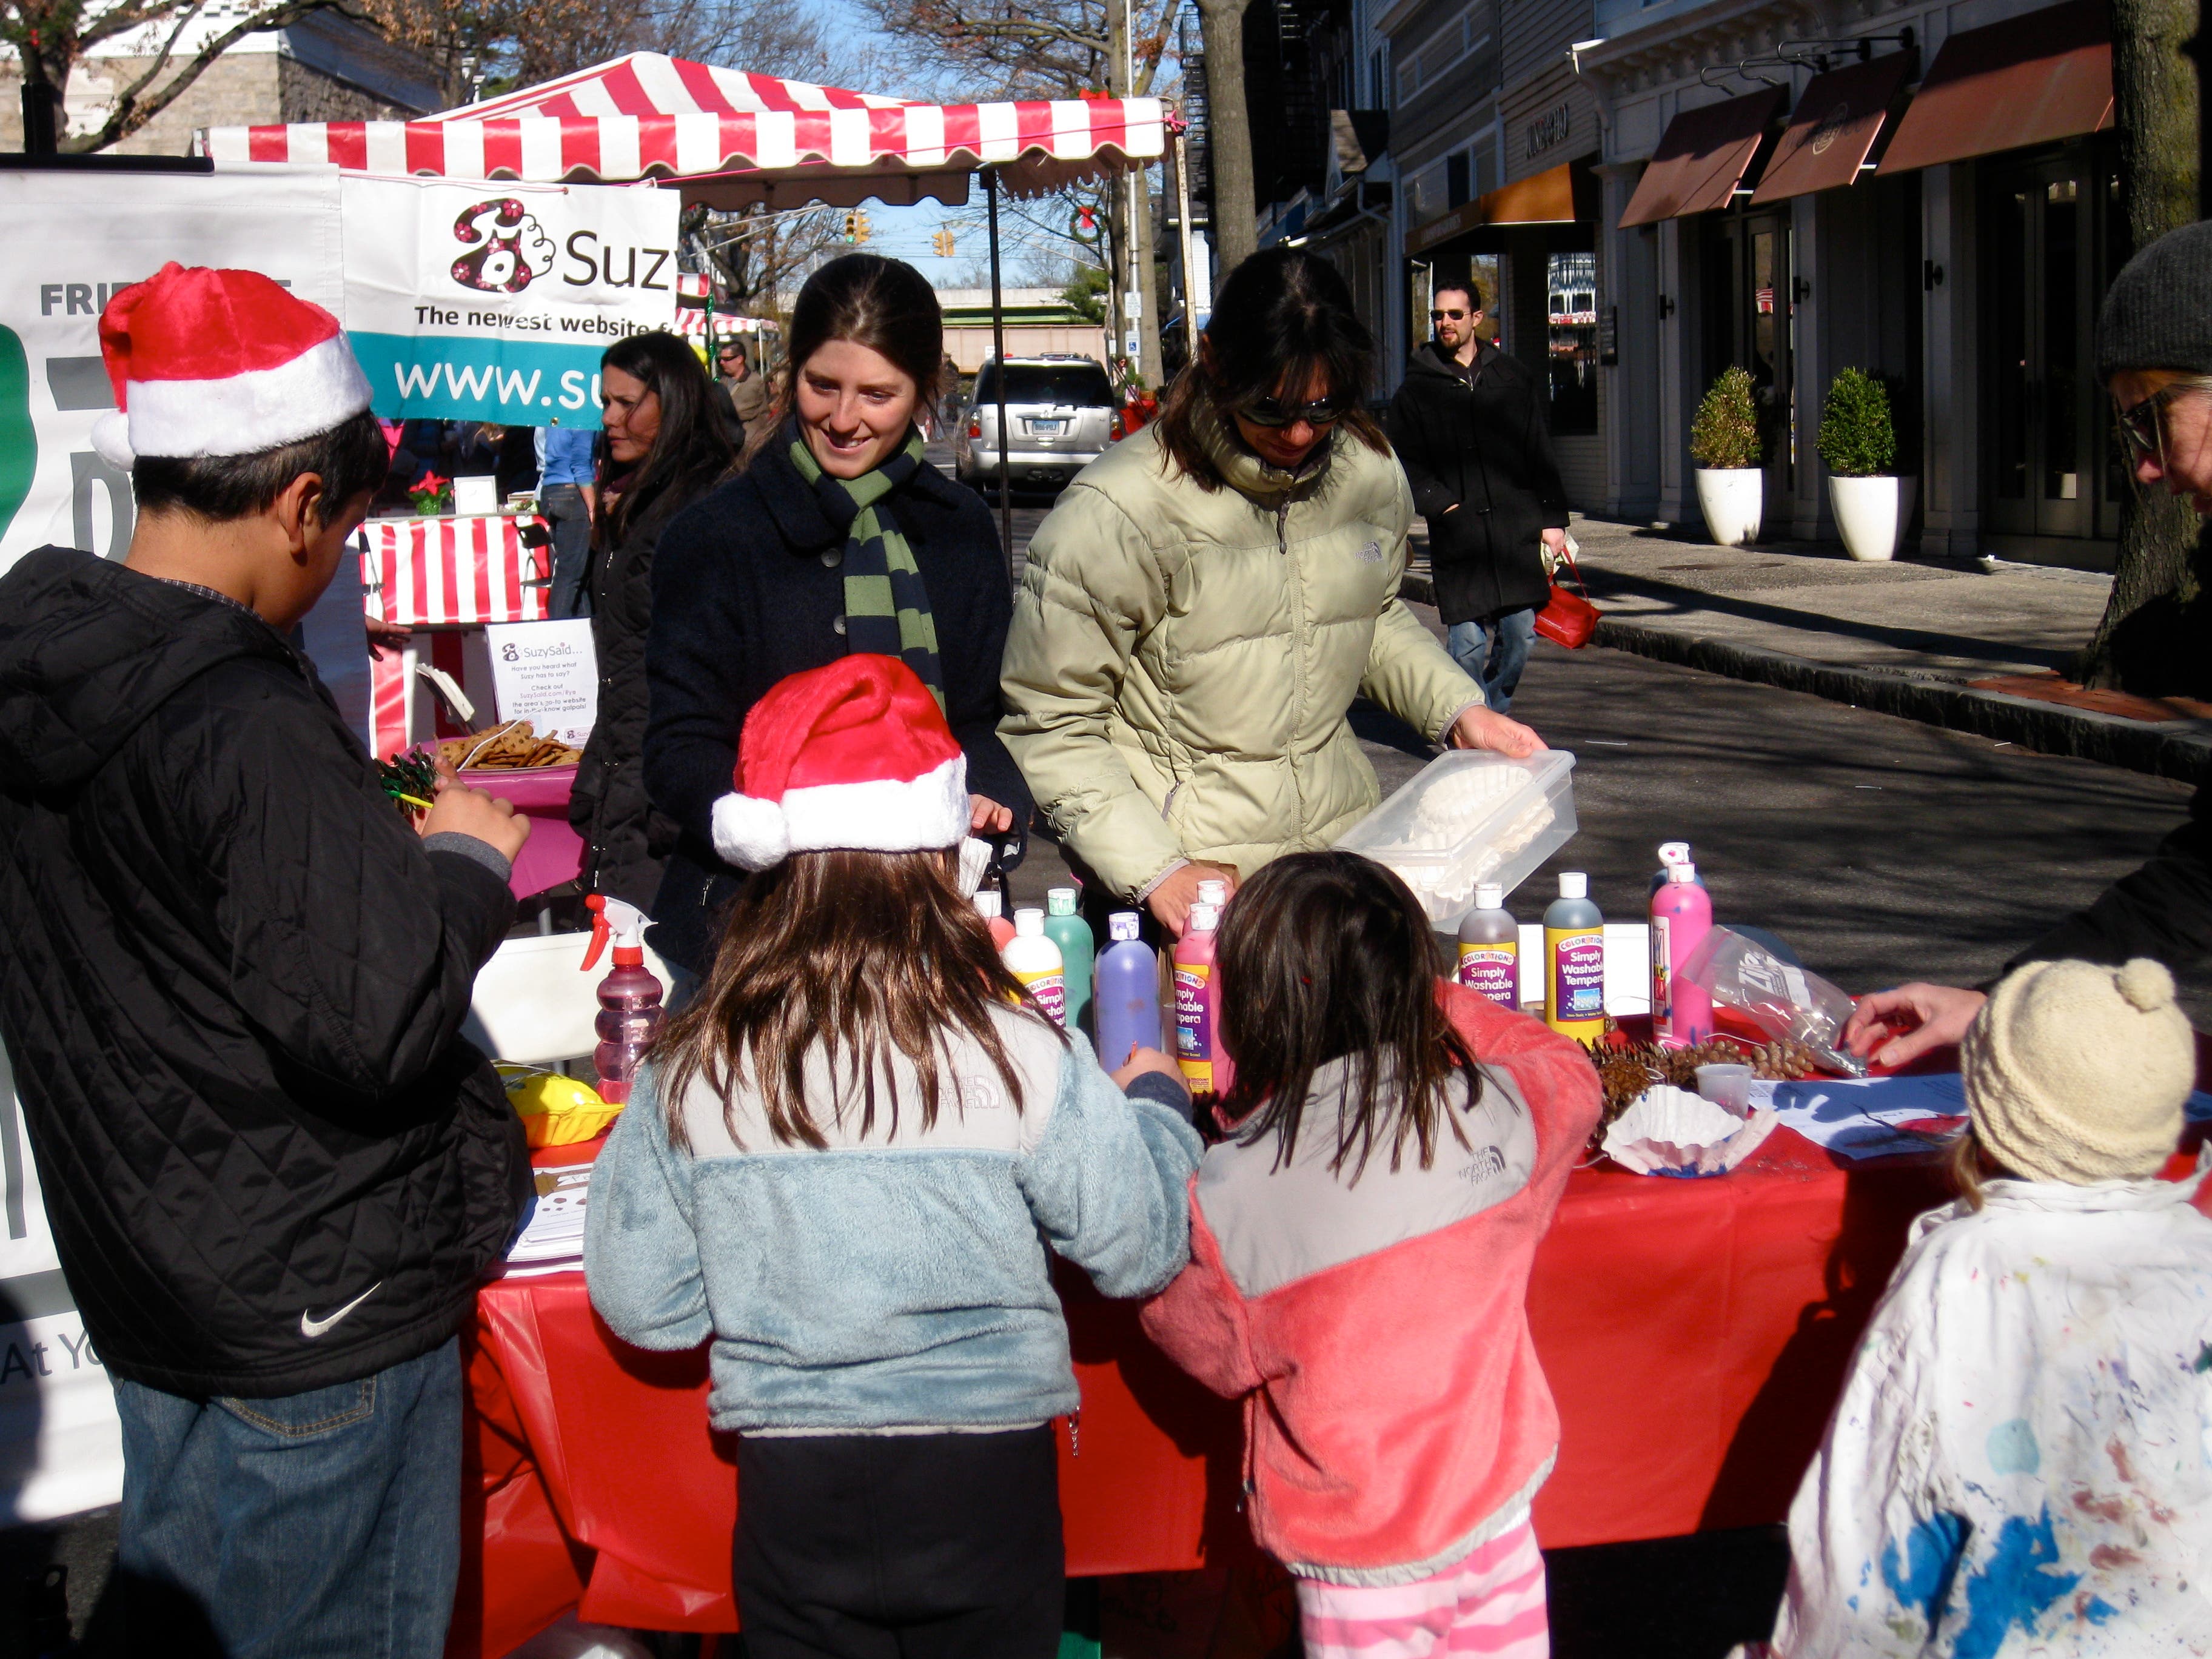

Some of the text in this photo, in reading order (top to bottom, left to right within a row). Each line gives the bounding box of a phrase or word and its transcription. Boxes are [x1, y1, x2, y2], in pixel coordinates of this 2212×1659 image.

[563, 230, 678, 290] Suz
[414, 306, 459, 326] The
[467, 310, 552, 331] newest
[560, 314, 649, 337] website
[562, 703, 586, 712] galpals!
[1464, 952, 1513, 964] COLORATIONS
[1570, 950, 1601, 964] Simply
[1470, 967, 1506, 980] Simply
[1465, 978, 1513, 990] Washable
[1176, 988, 1195, 1002] mply
[1483, 991, 1512, 1001] pera
[1176, 1013, 1201, 1024] mpera
[1470, 1147, 1489, 1162] THE
[1459, 1156, 1492, 1179] NORTH
[1471, 1168, 1493, 1187] FACE
[1, 1342, 53, 1385] At
